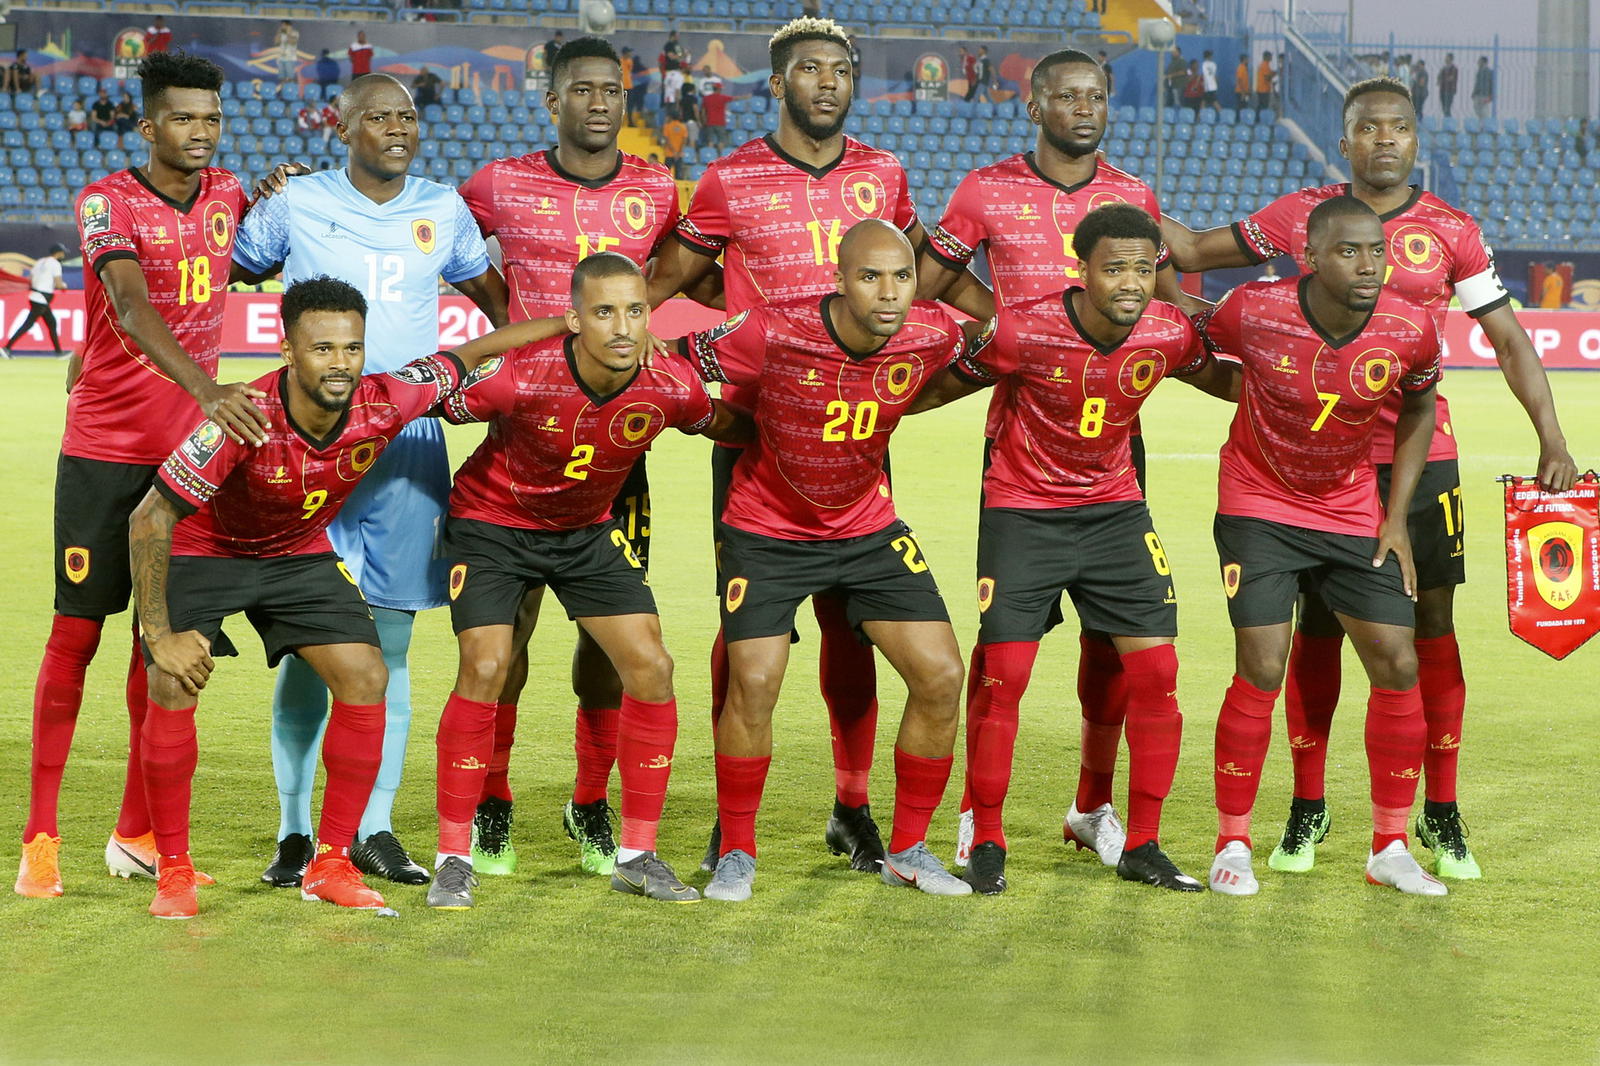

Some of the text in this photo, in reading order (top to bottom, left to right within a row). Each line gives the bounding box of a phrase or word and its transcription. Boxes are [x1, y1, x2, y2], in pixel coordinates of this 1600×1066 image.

[177, 255, 212, 305] 18
[363, 253, 405, 302] 12
[822, 399, 879, 442] 20
[1079, 397, 1106, 438] 8
[1310, 392, 1341, 432] 7
[563, 444, 595, 481] 2
[301, 489, 328, 520] 9
[1144, 531, 1170, 576] 8
